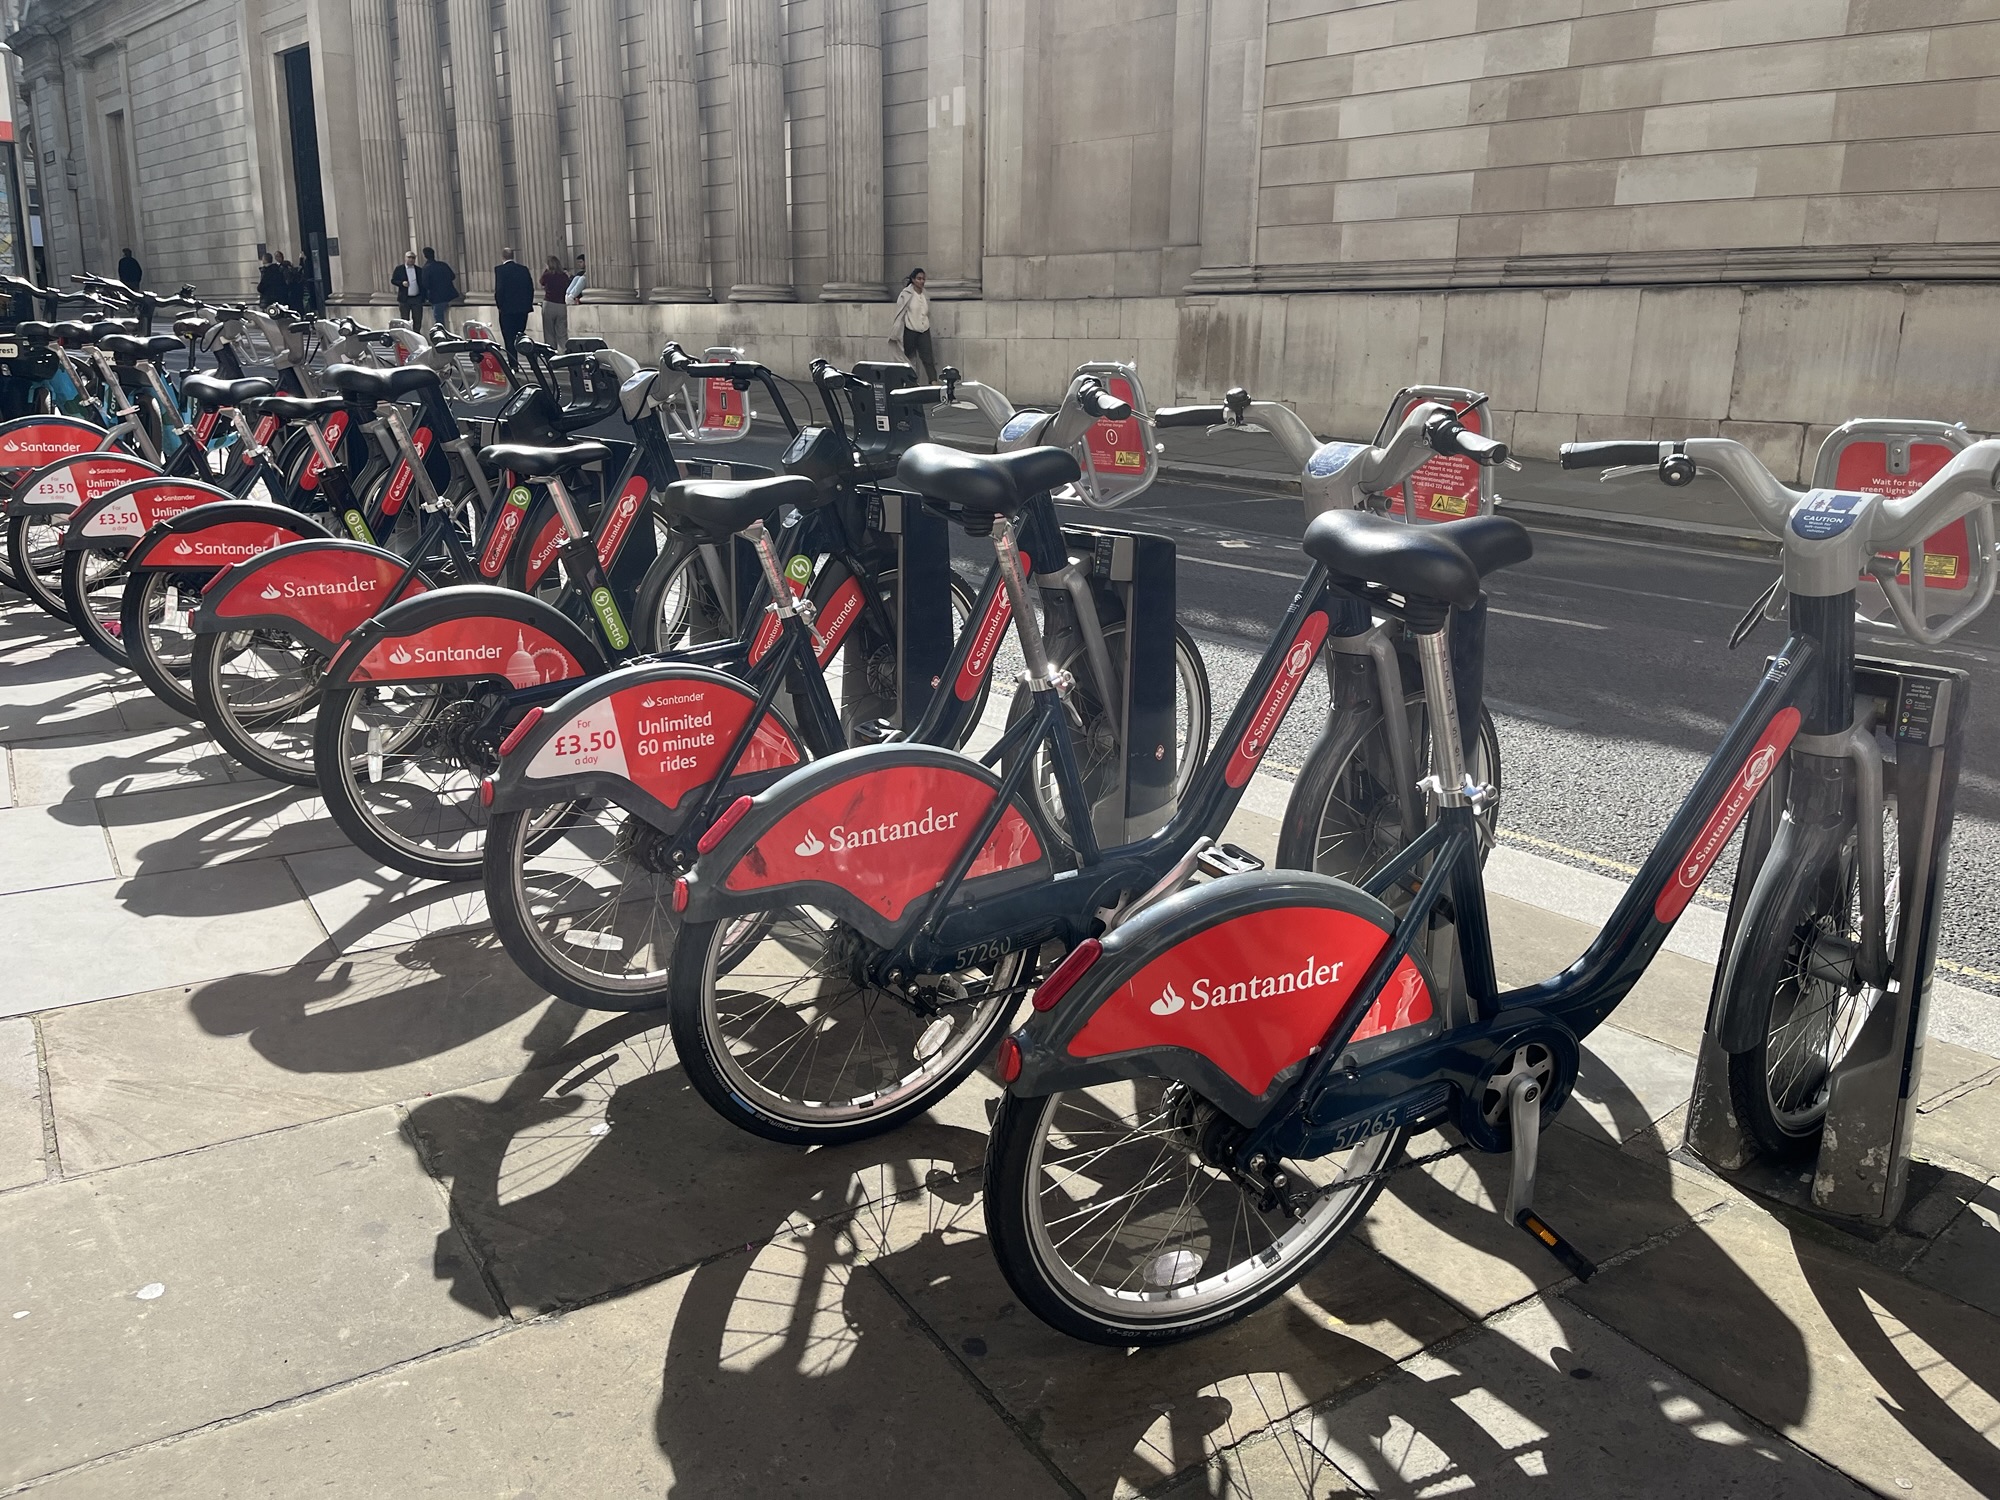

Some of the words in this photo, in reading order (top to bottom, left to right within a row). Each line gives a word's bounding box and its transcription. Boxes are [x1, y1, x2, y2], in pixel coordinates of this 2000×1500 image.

[20, 442, 81, 453] Santander
[39, 483, 74, 494] £3.50
[396, 466, 412, 491] Santand
[1872, 477, 1892, 486] Wait
[1893, 479, 1907, 487] for
[162, 494, 196, 503] Santander
[1886, 487, 1906, 495] light
[99, 512, 138, 525] £3.50
[1803, 515, 1844, 524] CAUTION
[602, 519, 624, 555] Santander
[195, 542, 268, 556] Santander
[284, 575, 377, 599] Santander
[602, 606, 625, 647] Electric
[976, 610, 1003, 660] Santander
[415, 645, 503, 663] Santander
[656, 692, 705, 707] Santander
[1254, 680, 1290, 739] Santander
[577, 719, 591, 729] For
[638, 711, 712, 736] Unlimited
[555, 730, 616, 756] £3.50
[637, 740, 659, 756] 60
[662, 733, 715, 754] minute
[575, 758, 581, 766] a
[583, 754, 599, 767] day
[660, 756, 697, 773] rides
[829, 806, 959, 852] Santander
[1696, 792, 1745, 863] Santander
[955, 936, 1012, 970] 57260
[1190, 955, 1343, 1011] Santander
[697, 1025, 707, 1050] PLUS
[754, 1112, 800, 1133] SCHWALBE
[1332, 1108, 1398, 1151] 57265
